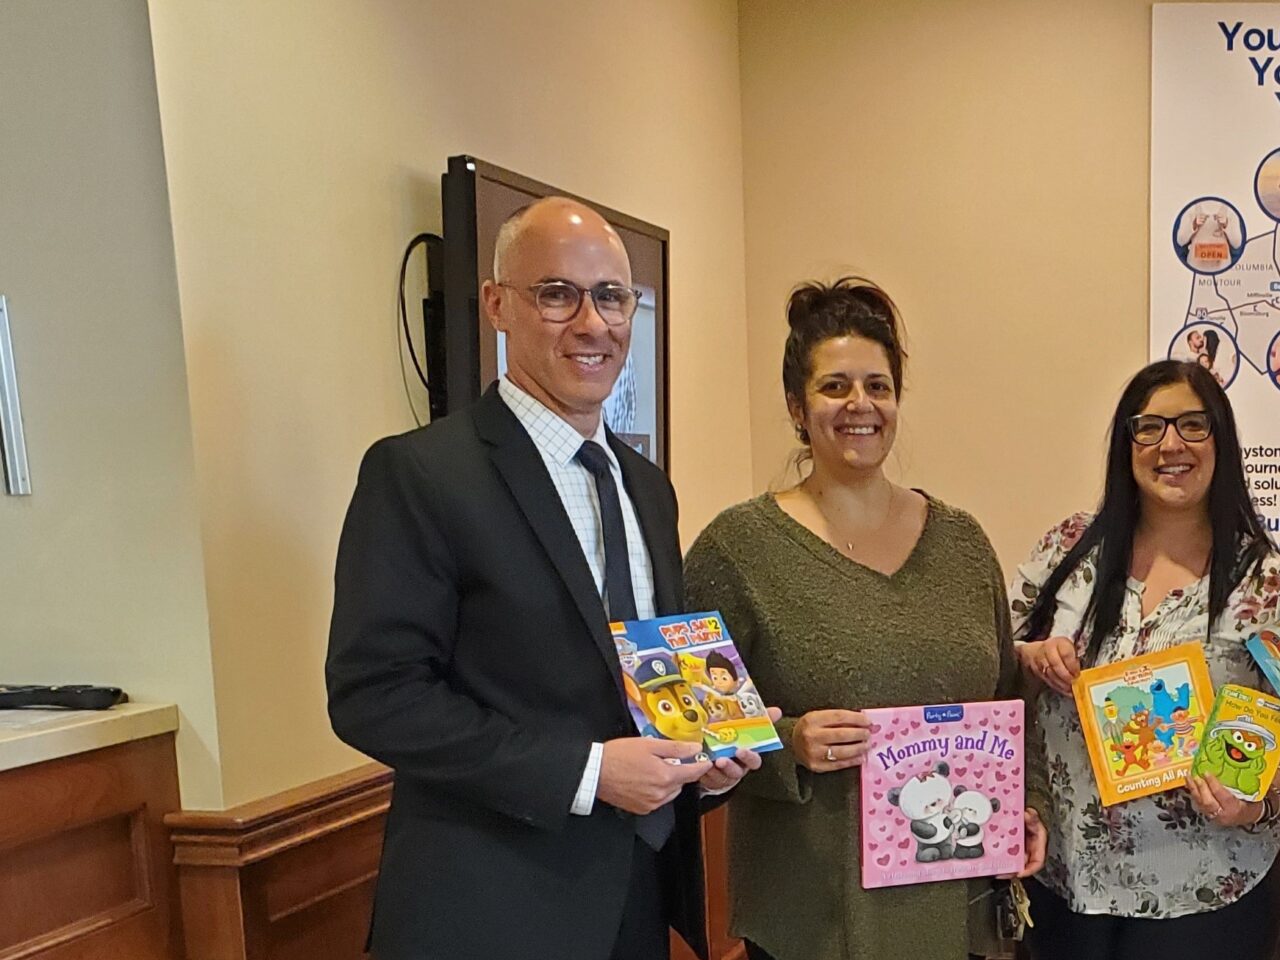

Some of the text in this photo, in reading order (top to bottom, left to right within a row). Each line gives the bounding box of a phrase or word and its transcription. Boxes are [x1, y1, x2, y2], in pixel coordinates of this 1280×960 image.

[1226, 700, 1242, 710] How
[1257, 710, 1268, 719] You
[877, 731, 1015, 770] Mommy and Me
[1117, 777, 1161, 794] Counting
[1163, 772, 1175, 783] All
